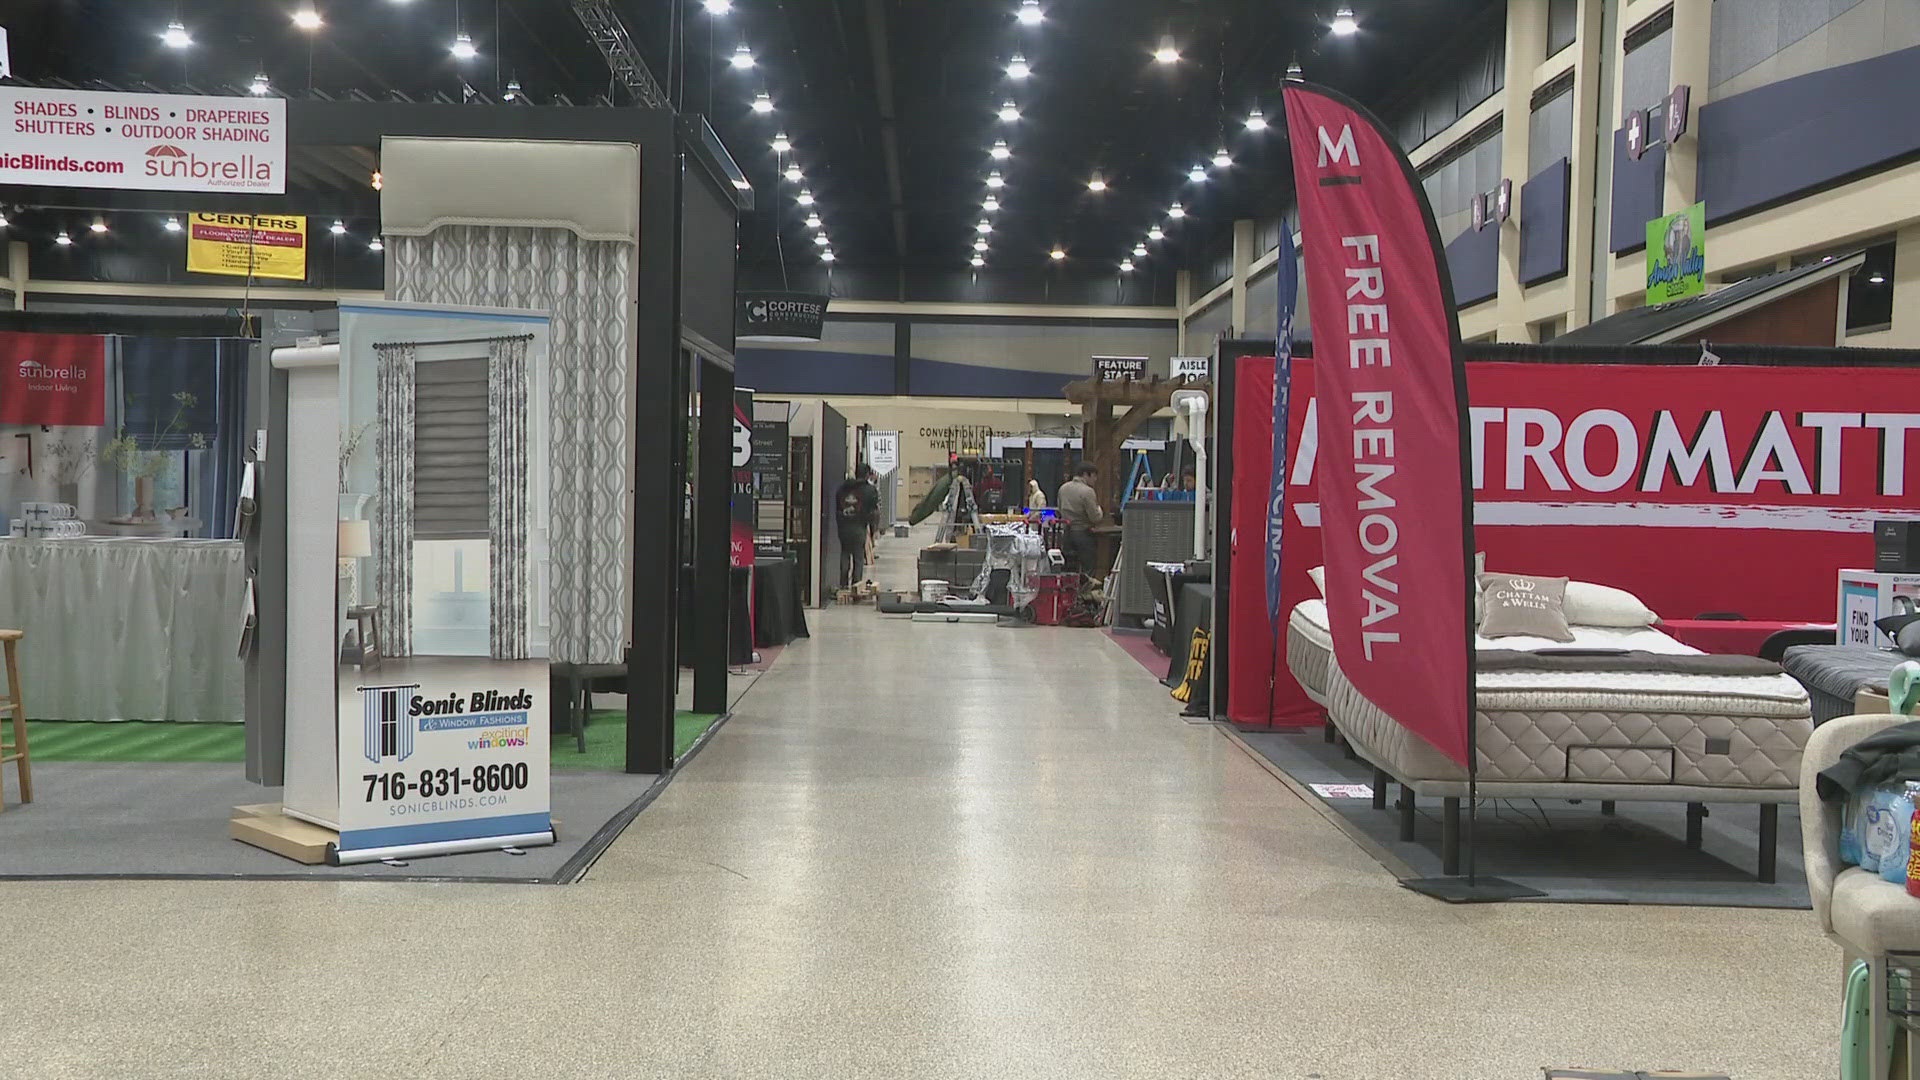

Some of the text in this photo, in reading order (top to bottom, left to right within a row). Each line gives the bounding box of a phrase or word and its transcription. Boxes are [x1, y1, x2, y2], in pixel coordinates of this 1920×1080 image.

[14, 100, 270, 125] SHADES BLINDS DRAPERIES
[14, 119, 270, 143] SHUTTERS OUTDOOR SHADING
[0, 153, 124, 173] icBlinds.com
[145, 153, 271, 180] sunbrella
[207, 179, 246, 187] Authorized
[198, 213, 298, 230] CENTERS
[768, 301, 821, 315] CORTESE
[19, 364, 87, 380] sunbrella
[1099, 360, 1142, 370] FEATURE
[1179, 360, 1206, 370] AISLE
[28, 383, 78, 393] Indoor Living
[920, 427, 974, 438] CONVENTION
[930, 440, 956, 449] HYATT
[1342, 234, 1401, 663] FREE REMOVAL
[1496, 590, 1550, 602] CHATTAM
[1510, 598, 1546, 609] WELLS
[1852, 609, 1869, 627] FIND
[1850, 626, 1869, 645] YOUR
[408, 688, 533, 717] Sonic Blinds
[440, 718, 477, 728] WINDOW
[479, 715, 523, 725] FASHIONS
[363, 762, 529, 803] 716-831-8600
[389, 795, 508, 816] SONICBLINDS.COM
